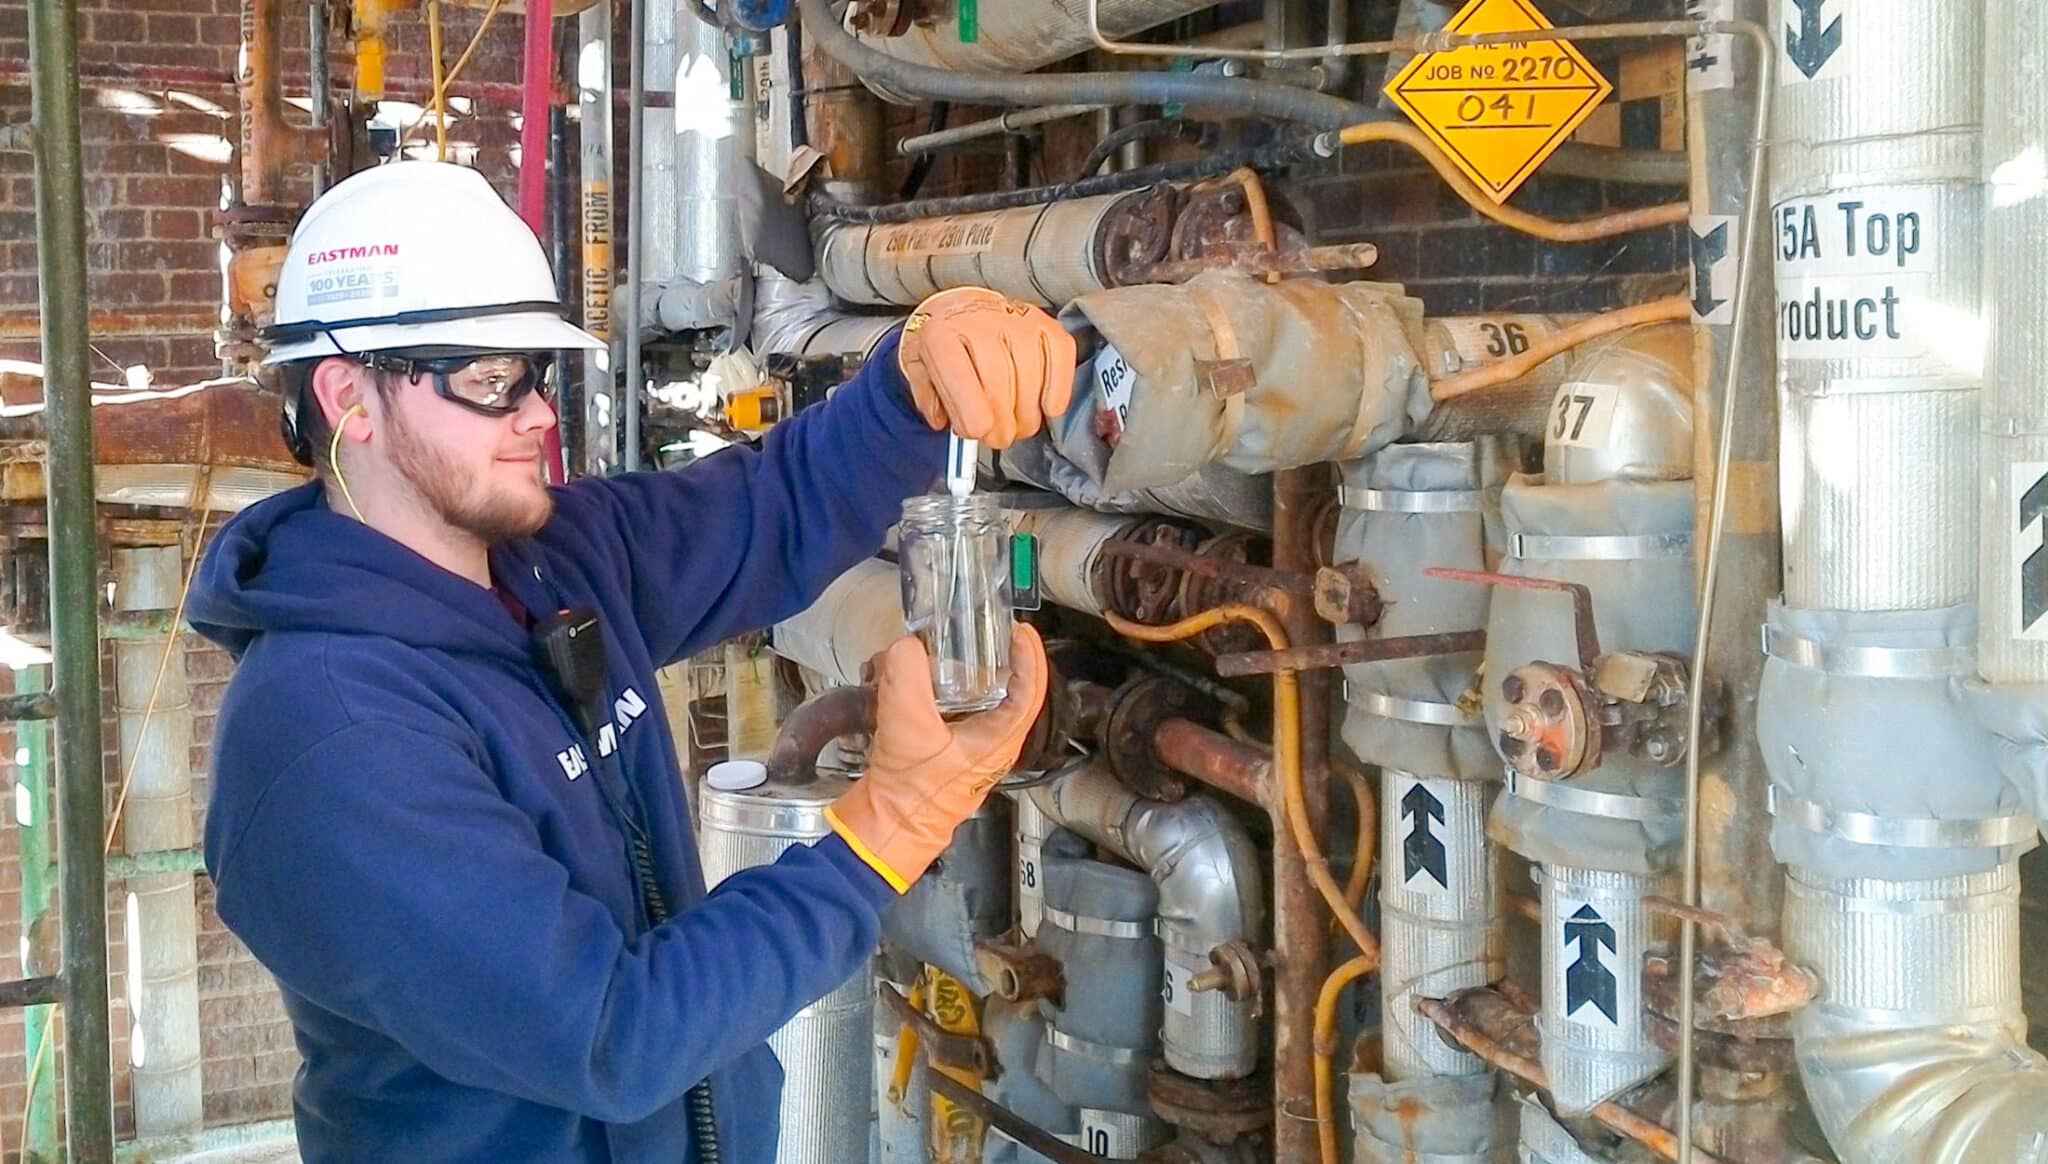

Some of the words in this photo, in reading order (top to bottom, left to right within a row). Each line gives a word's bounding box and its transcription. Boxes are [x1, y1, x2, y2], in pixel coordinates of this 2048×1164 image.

[1426, 65, 1462, 80] JOB
[1503, 56, 1575, 82] 2270
[1458, 94, 1536, 122] 041
[585, 191, 608, 245] FROM
[1838, 201, 1920, 267] Top
[308, 244, 399, 265] EASTMAN
[310, 278, 333, 293] 100
[336, 271, 393, 288] YEAS
[587, 267, 608, 332] ACETIC
[1481, 322, 1530, 357] 36
[1553, 394, 1595, 441] 37
[556, 687, 648, 781] EAMN
